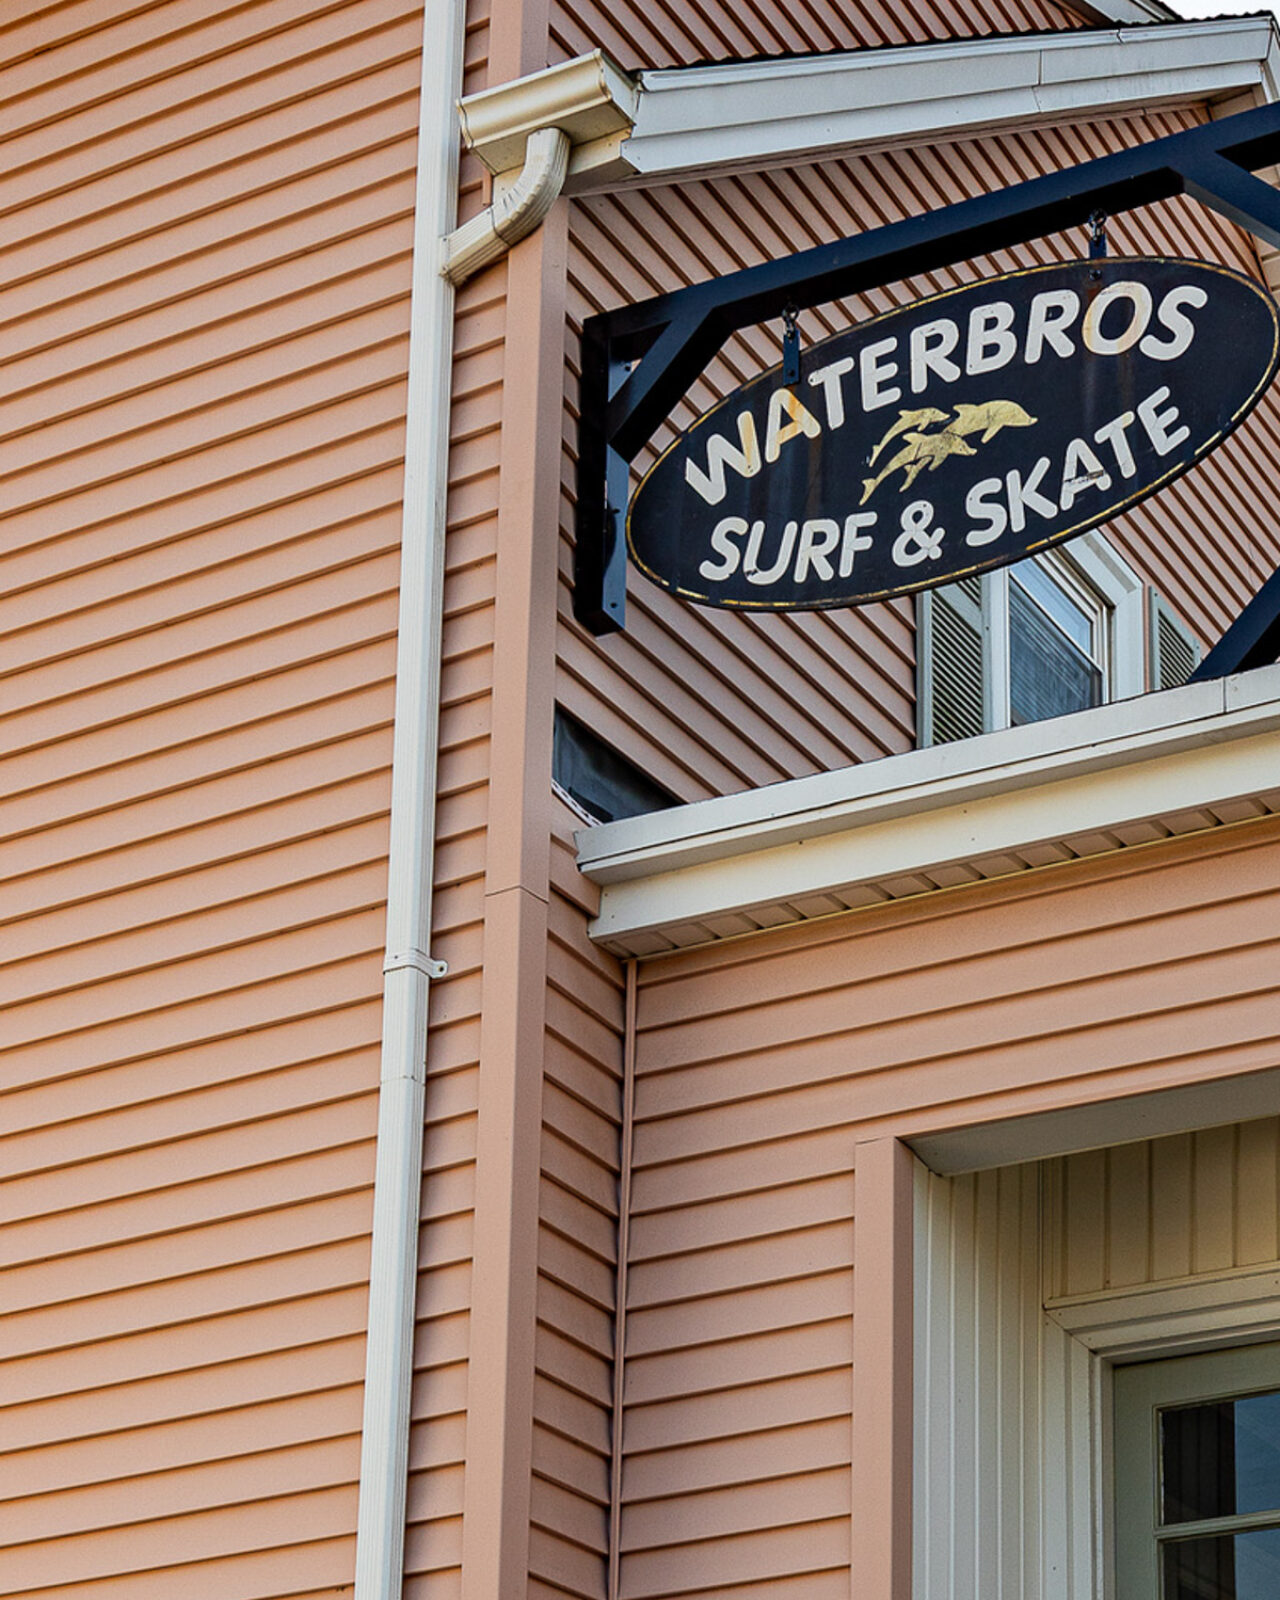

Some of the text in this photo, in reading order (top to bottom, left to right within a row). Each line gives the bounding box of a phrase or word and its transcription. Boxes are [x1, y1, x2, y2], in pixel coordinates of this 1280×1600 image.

[685, 281, 1207, 506] WATERBROS
[699, 386, 1190, 585] SURF & SKATE
